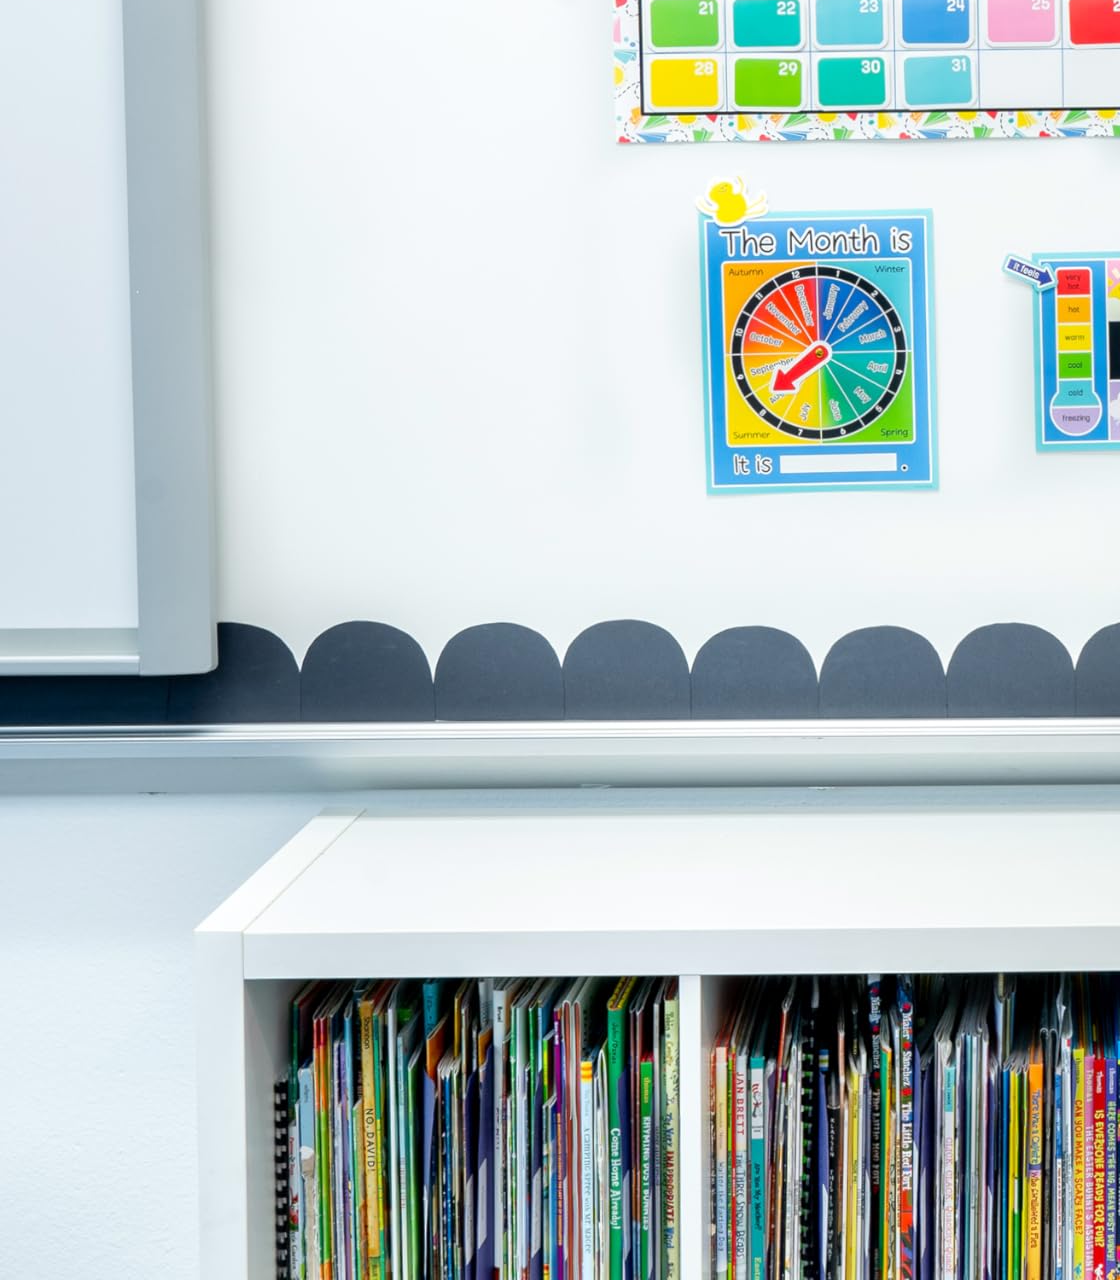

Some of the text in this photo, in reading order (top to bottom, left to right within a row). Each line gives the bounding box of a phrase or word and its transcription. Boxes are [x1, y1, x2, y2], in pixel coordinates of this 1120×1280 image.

[698, 1, 714, 16] 21
[777, 1, 797, 16] 22
[859, 0, 879, 14] 23
[946, 0, 966, 12] 24
[694, 59, 967, 76] 28 29 30 31
[720, 225, 911, 256] The Month is
[728, 268, 764, 277] Autumn
[874, 265, 906, 274] Winter
[795, 284, 814, 326] December
[1067, 305, 1080, 314] hot
[766, 303, 801, 335] November
[749, 332, 783, 347] October
[859, 330, 887, 344] March
[867, 361, 889, 373] April
[1067, 361, 1083, 370] cool
[1061, 414, 1091, 424] freezing
[733, 431, 771, 440] Summer
[880, 428, 909, 439] Spring
[733, 455, 772, 475] It is
[363, 1016, 371, 1050] Shannon
[901, 1013, 912, 1040] Maier
[736, 1071, 745, 1137] JAN BRETT
[901, 1102, 912, 1122] The
[1073, 1099, 1083, 1118] CAN
[901, 1122, 912, 1151] Little
[1073, 1119, 1083, 1138] YOU
[366, 1132, 375, 1173] DAVID!
[901, 1151, 912, 1169] Red
[1074, 1141, 1083, 1166] MAKE
[609, 1128, 622, 1230] Come Home Already!
[901, 1170, 912, 1192] Fort
[1094, 1110, 1105, 1248] IS EVERYONE READY FOR FUN?
[1073, 1177, 1084, 1207] SCARY
[1074, 1208, 1084, 1235] FACE?
